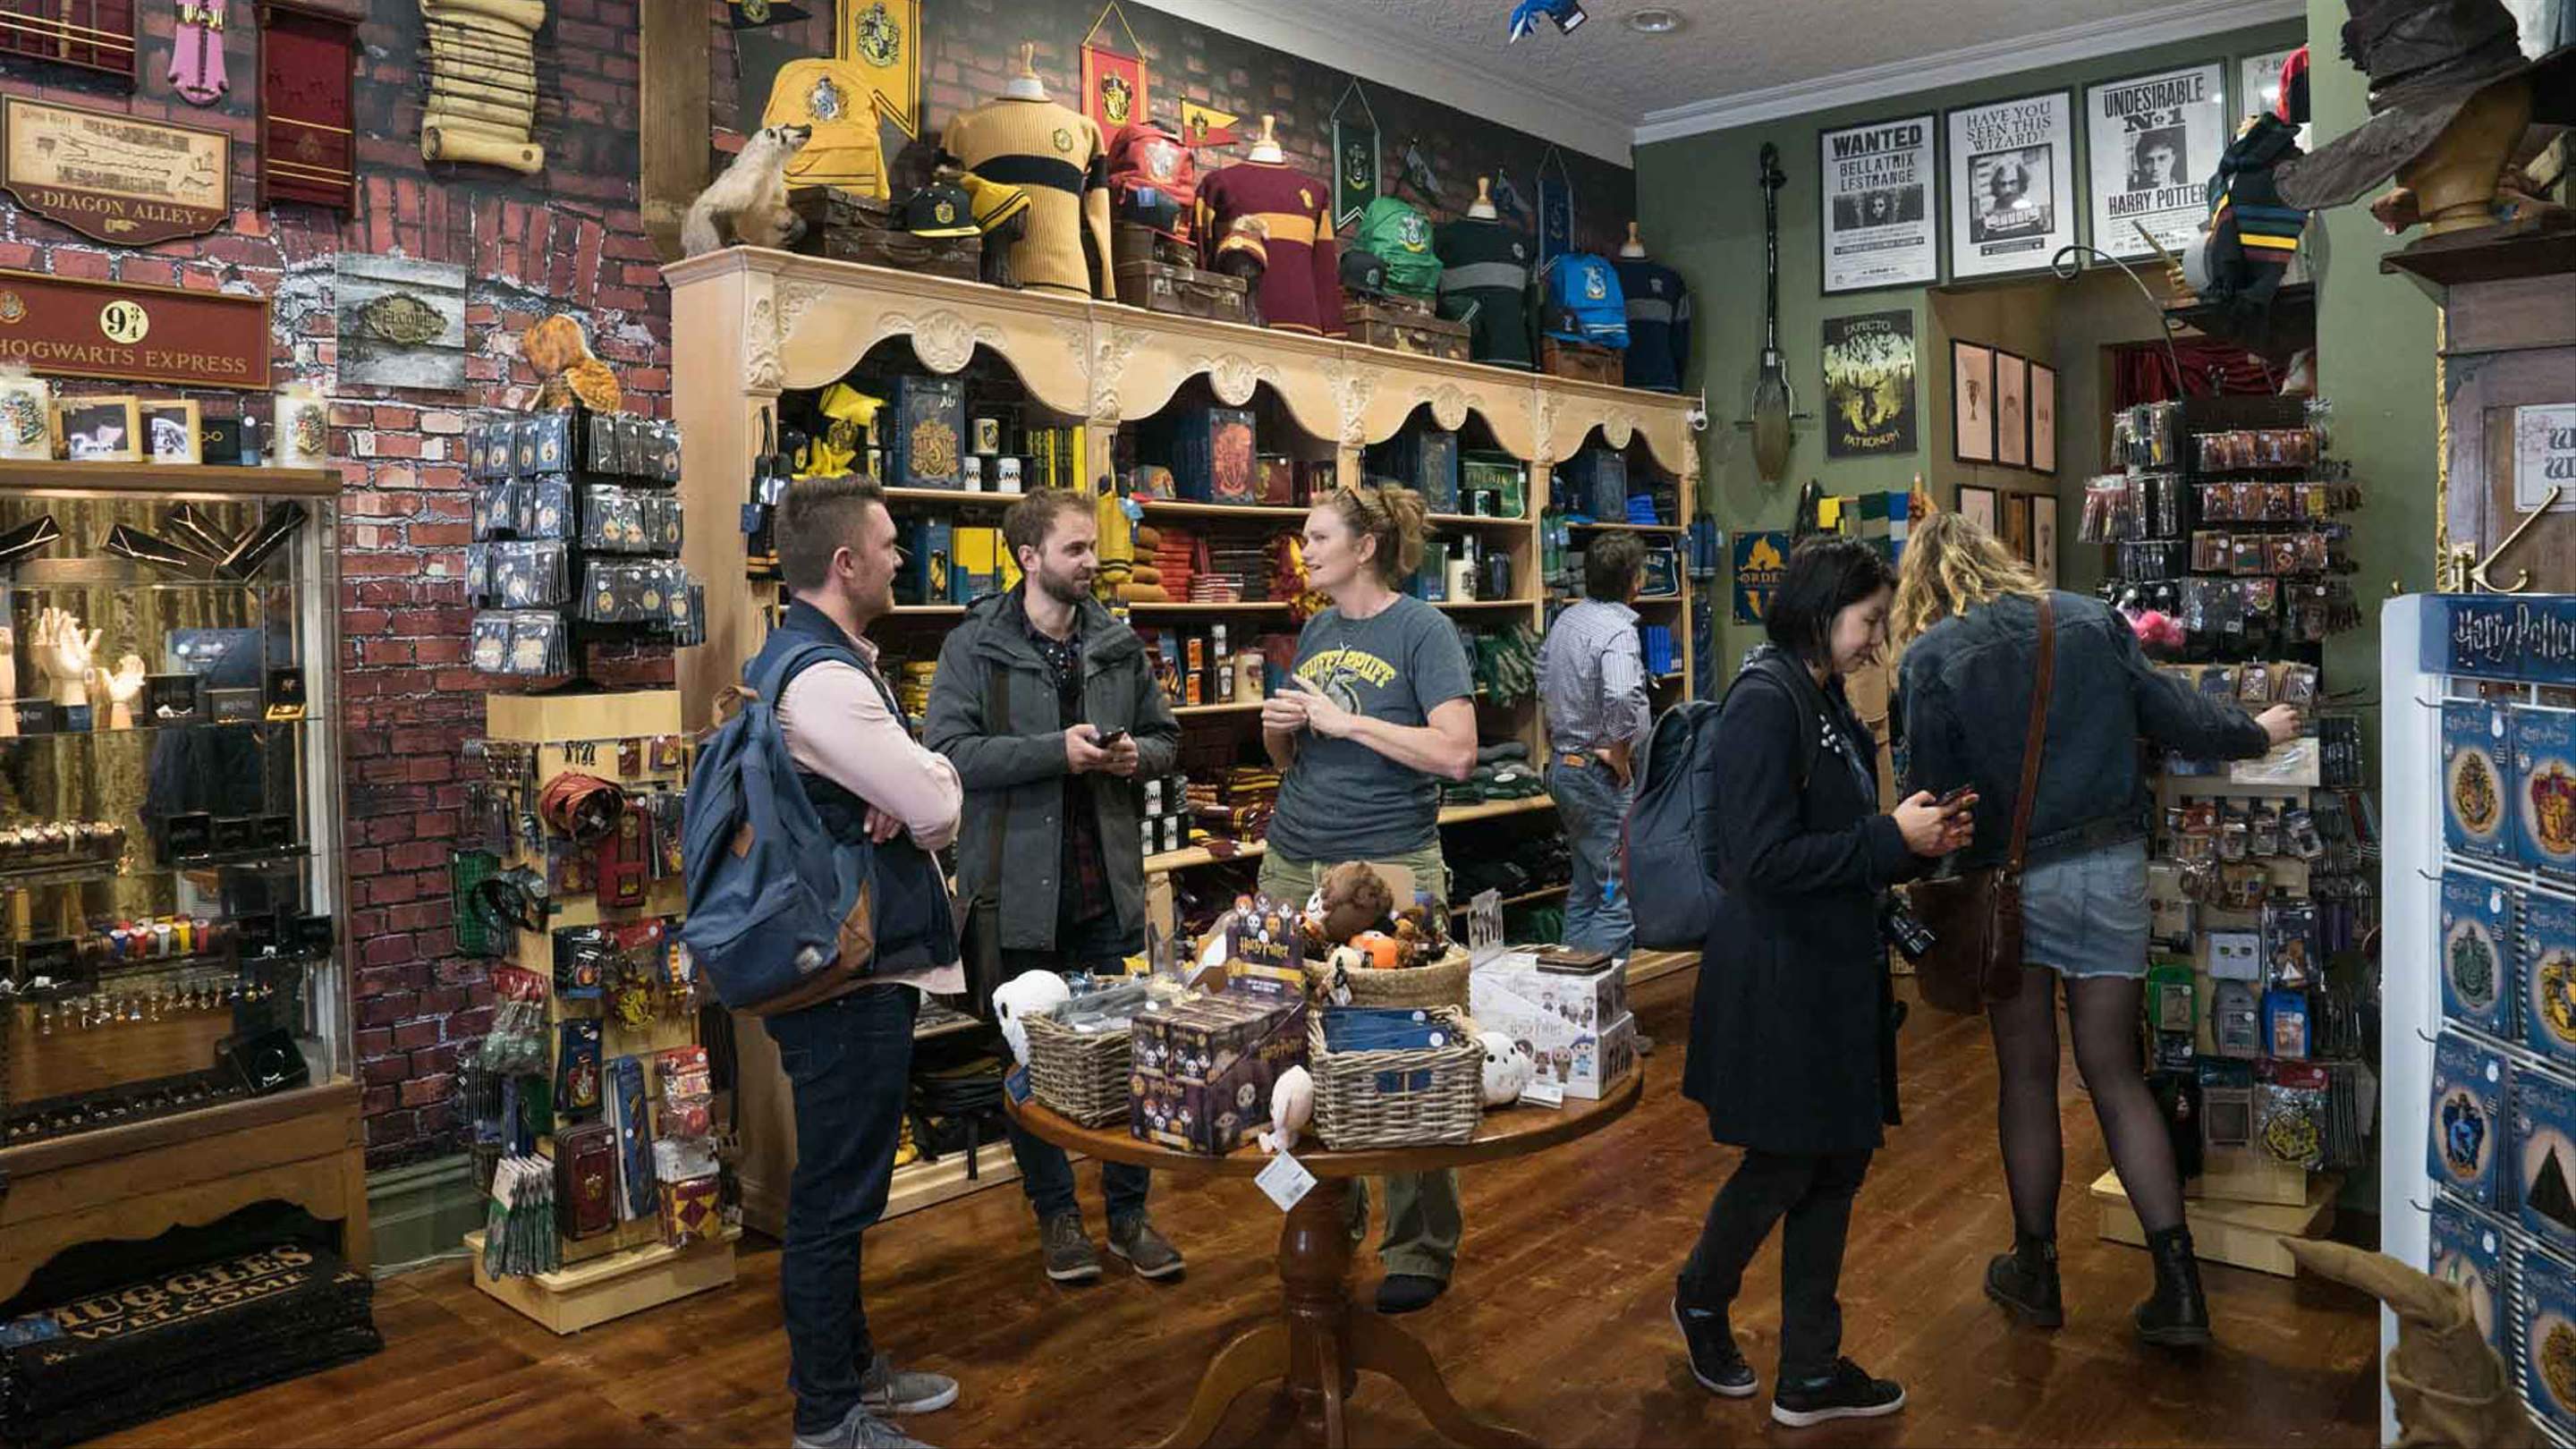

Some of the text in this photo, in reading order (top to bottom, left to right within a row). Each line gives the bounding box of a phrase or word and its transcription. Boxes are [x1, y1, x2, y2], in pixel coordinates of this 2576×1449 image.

[2104, 77, 2205, 118] UNDESIRABLE
[1967, 101, 2051, 129] HAVE YOU
[1967, 115, 2051, 141] SEEN THIS
[1833, 124, 1923, 157] WANTED
[1973, 130, 2046, 151] WIZARD?
[1840, 153, 1915, 176] BELLATRIX
[1841, 169, 1915, 192] LESTRANGE
[44, 191, 198, 225] DIAGON ALLEY
[2107, 183, 2207, 216] HARRY POTTER
[1843, 320, 1892, 335] EXPECTO
[146, 351, 248, 375] EXPRESS
[2453, 608, 2513, 667] Harry
[72, 1270, 312, 1340] WELCOME
